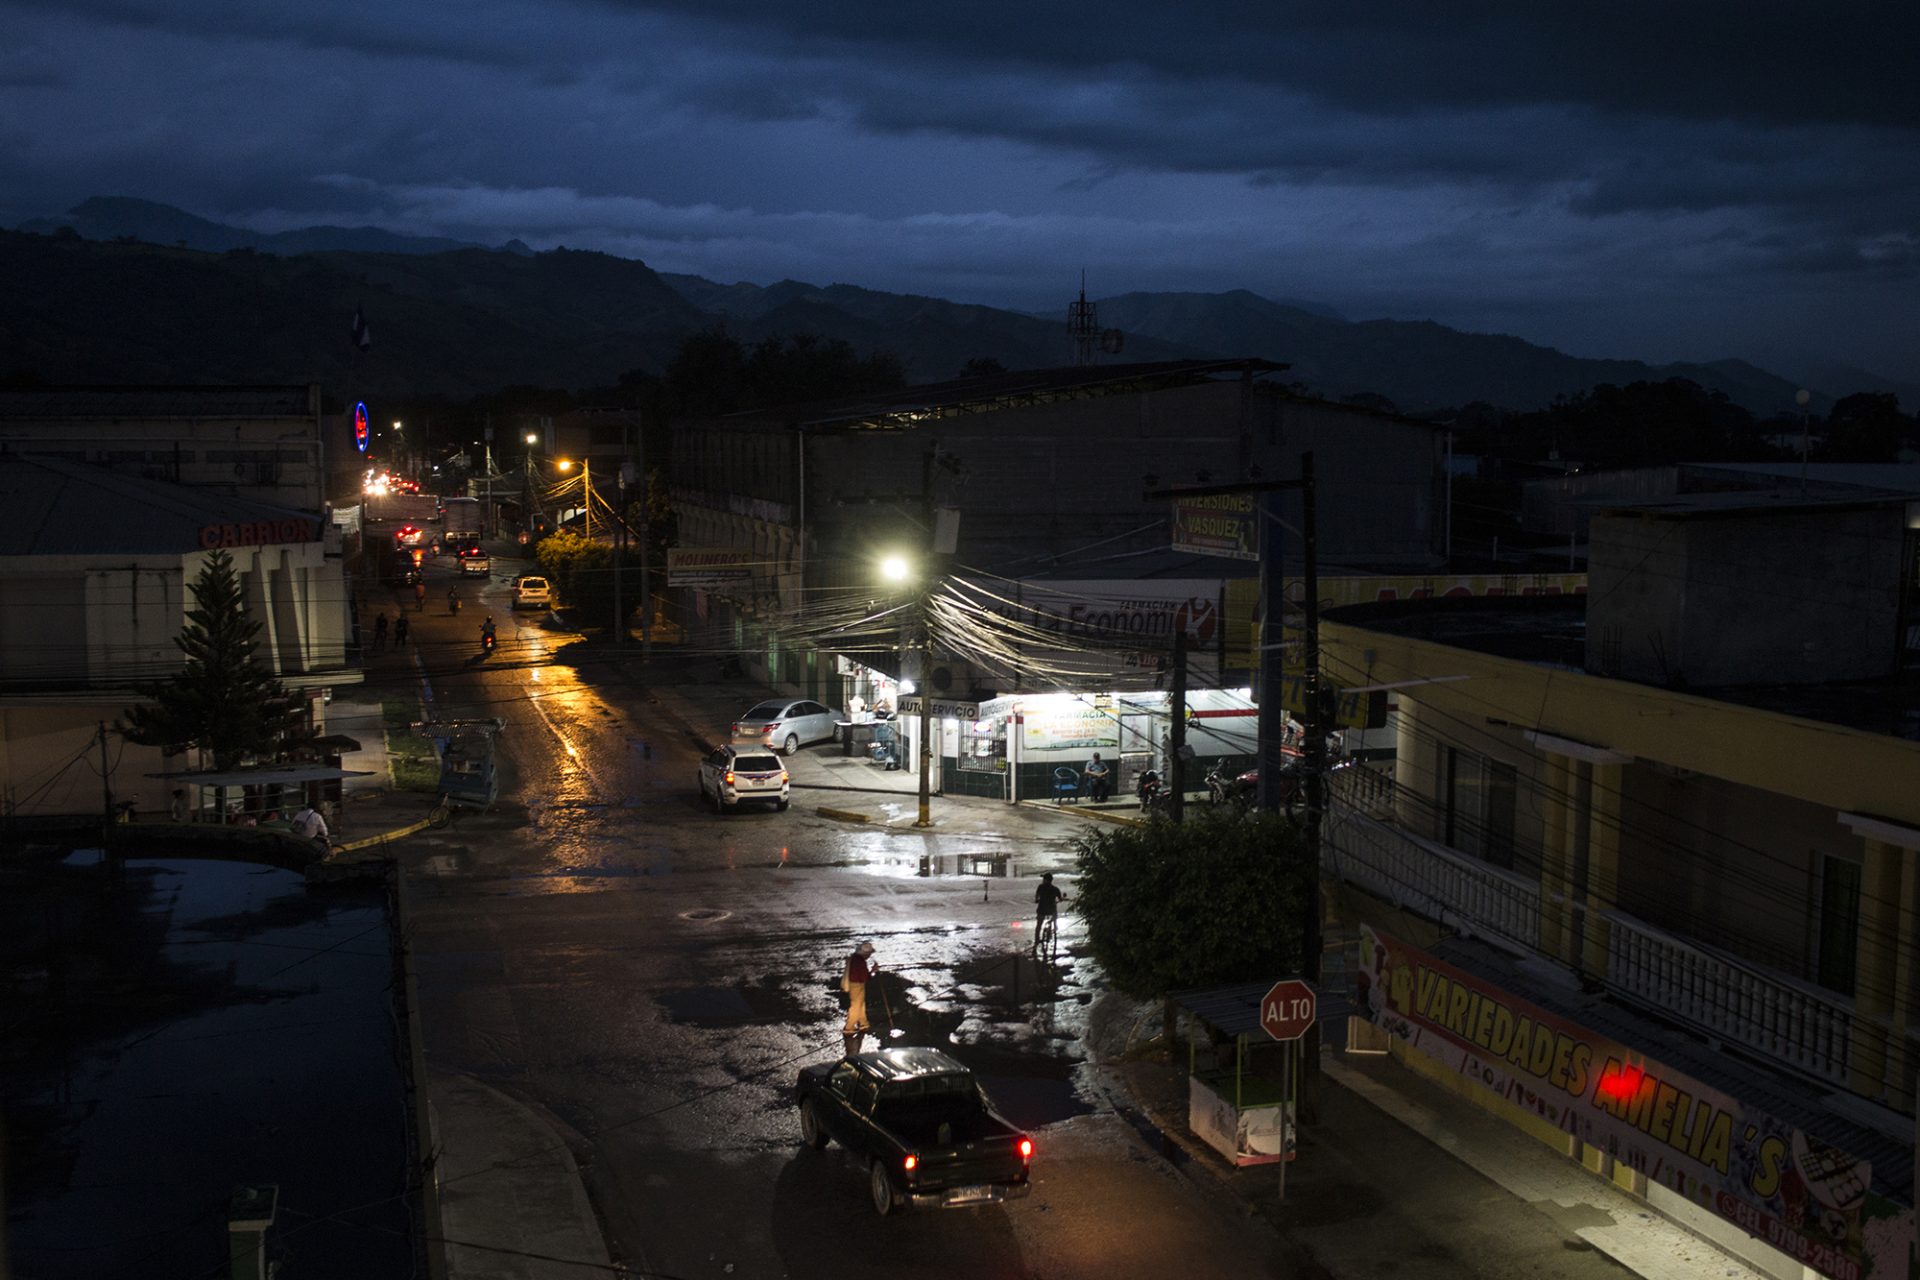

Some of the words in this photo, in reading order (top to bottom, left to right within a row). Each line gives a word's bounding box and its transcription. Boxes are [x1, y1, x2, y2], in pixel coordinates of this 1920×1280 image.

[1187, 516, 1240, 538] VASQUEZ
[898, 701, 976, 718] AUTOERVICIO
[1266, 998, 1311, 1023] ALTO
[1414, 963, 1593, 1098] VARIEDADES
